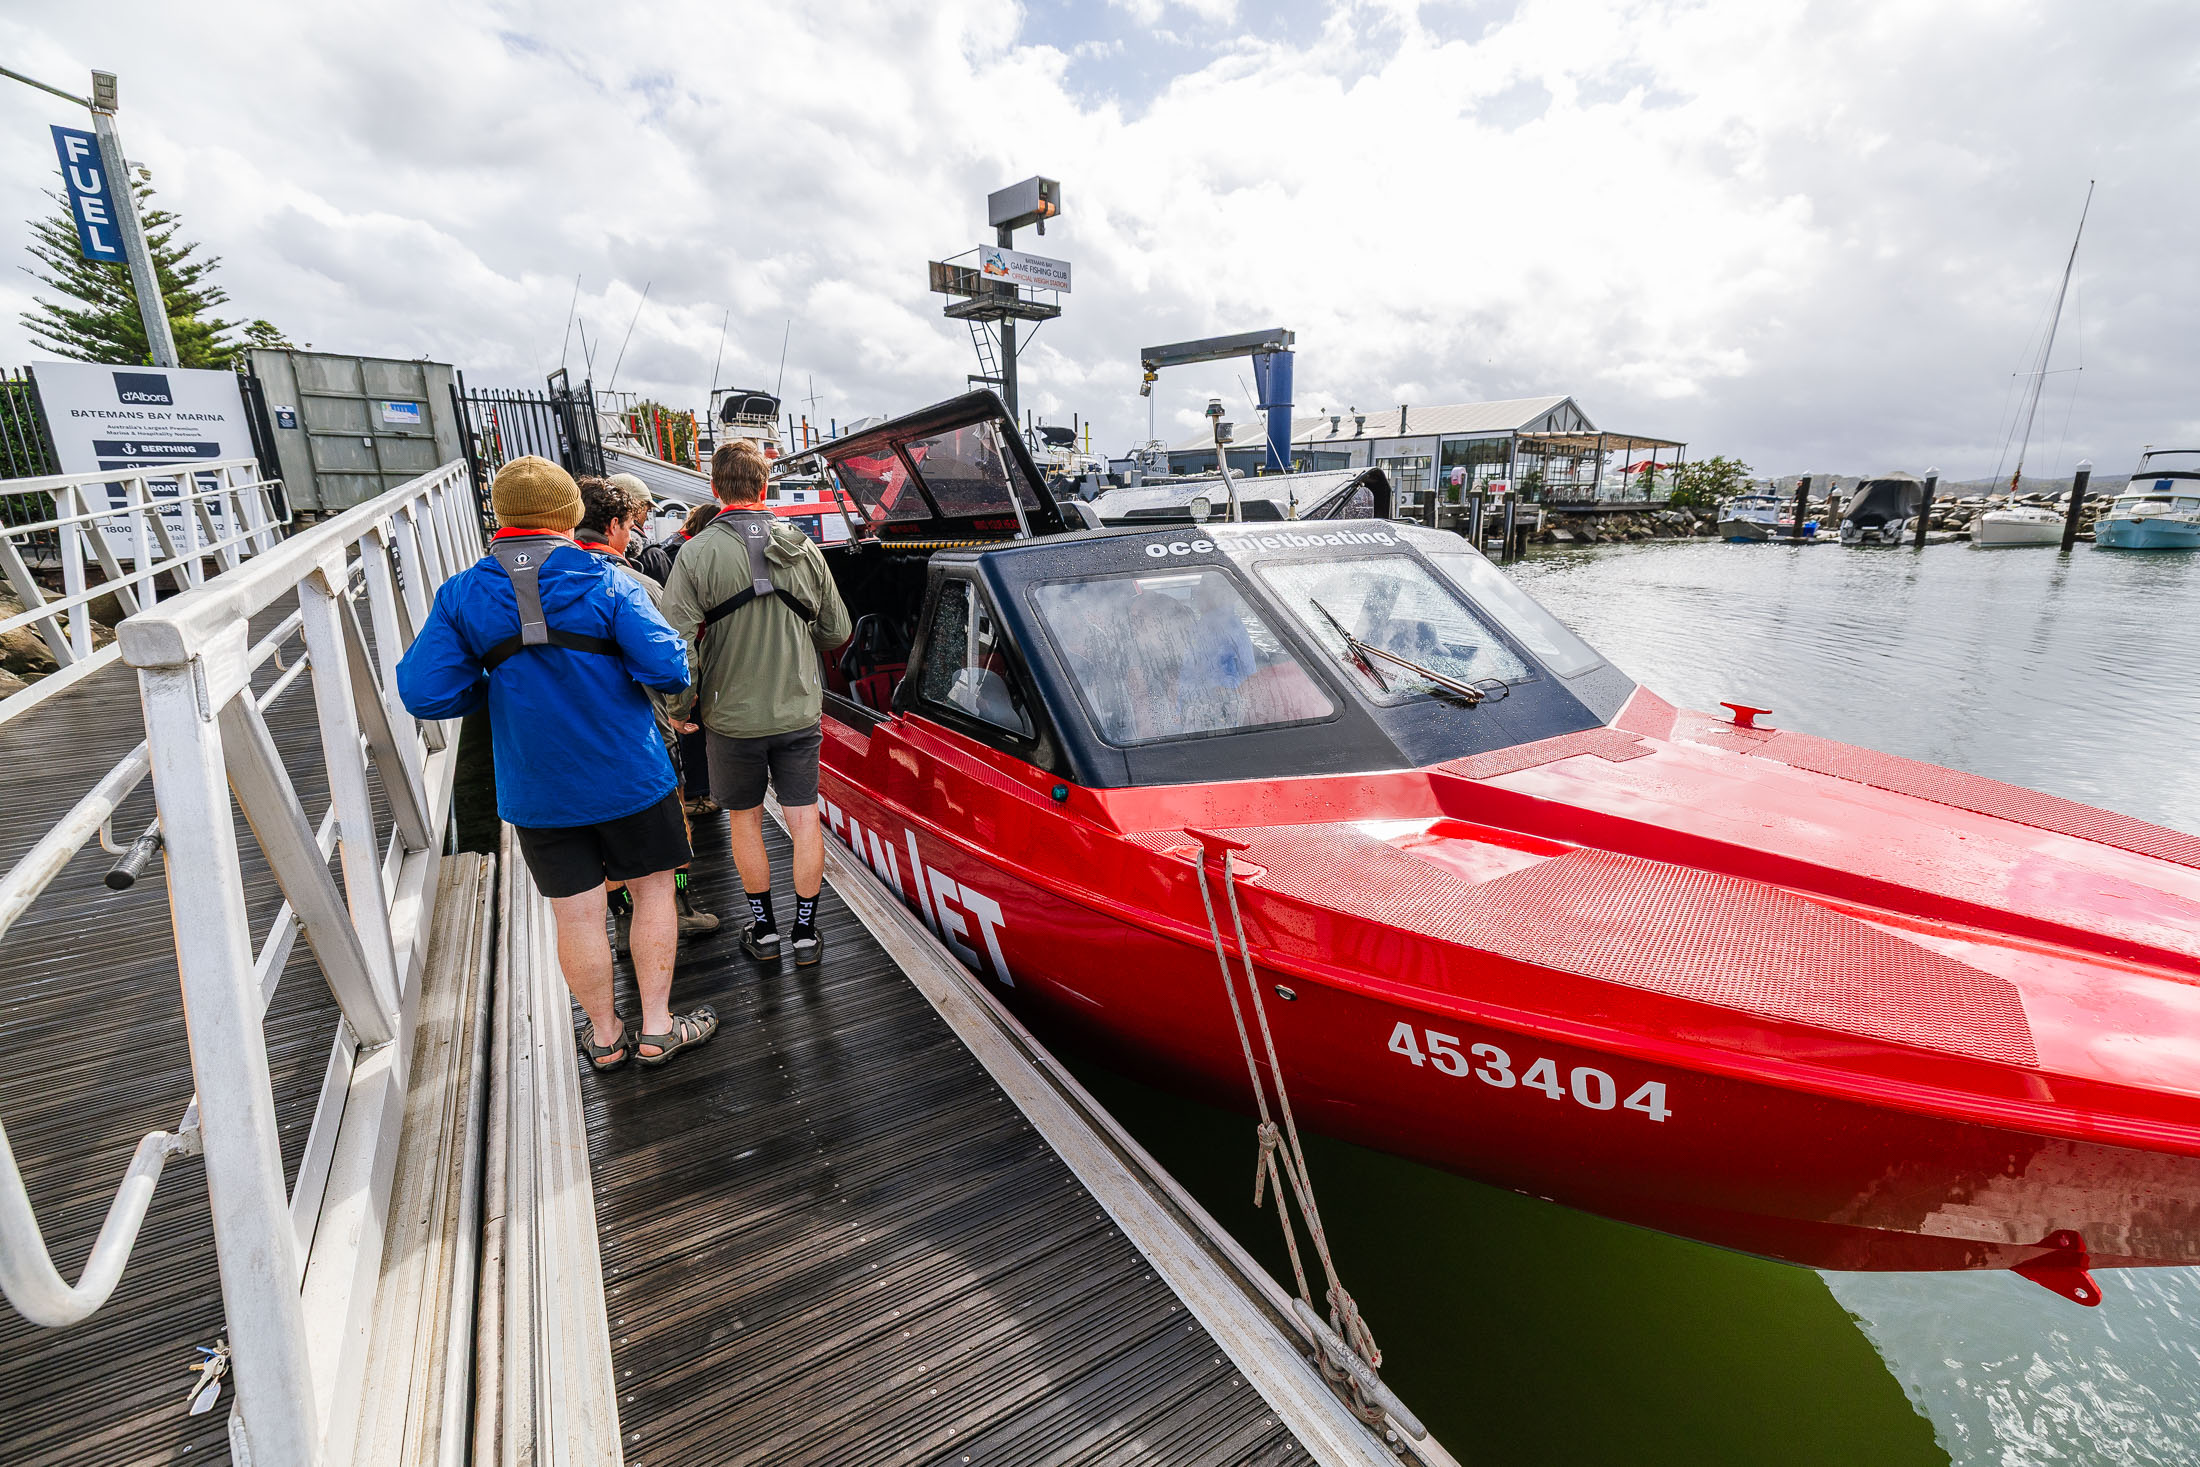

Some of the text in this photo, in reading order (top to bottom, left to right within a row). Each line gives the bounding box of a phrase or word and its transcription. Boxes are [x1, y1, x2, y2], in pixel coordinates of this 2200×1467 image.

[63, 135, 116, 253] FUEL
[1011, 262, 1068, 279] GAME FISHING CLUB
[1012, 272, 1068, 289] OFFICIAL WEIGH STATION
[122, 391, 169, 402] d'Albora
[71, 409, 225, 422] BATEMANS BAY MARINA
[141, 445, 197, 453] BERTHING
[149, 484, 178, 492] BOAT
[103, 525, 132, 533] 1800
[1144, 529, 1431, 558] oceanjetboating.c
[1387, 1021, 1672, 1123] 453404
